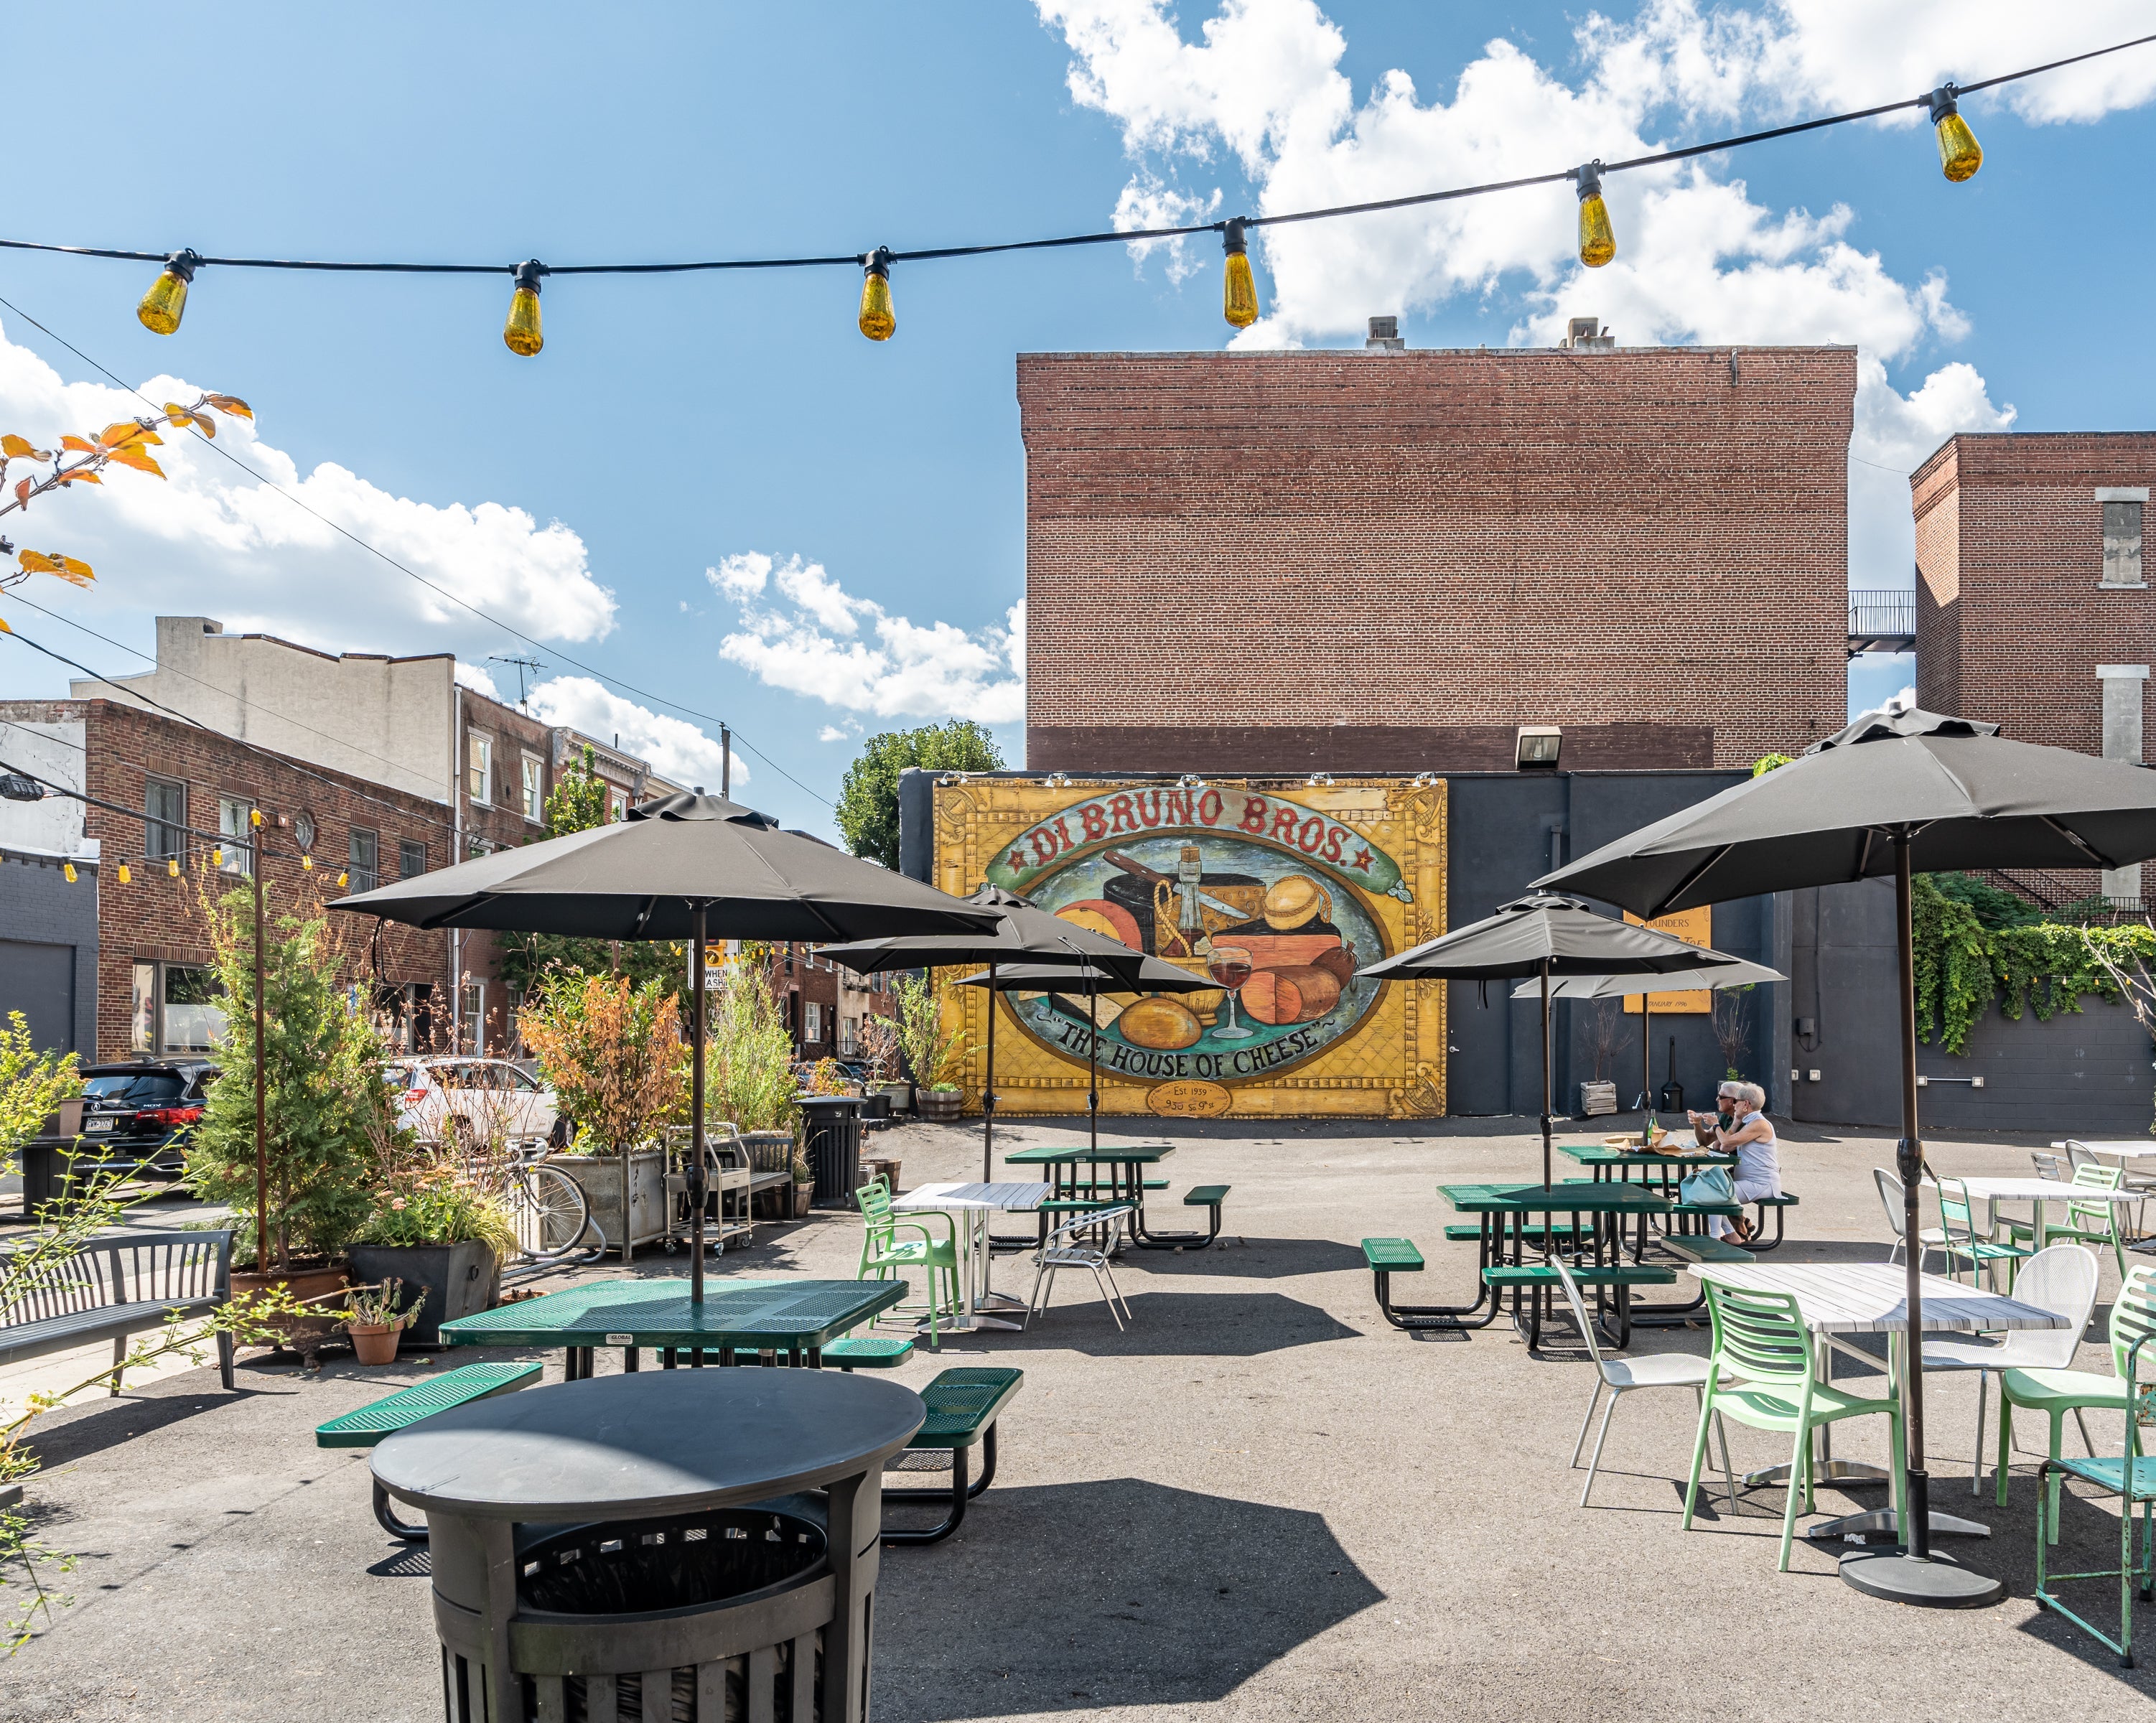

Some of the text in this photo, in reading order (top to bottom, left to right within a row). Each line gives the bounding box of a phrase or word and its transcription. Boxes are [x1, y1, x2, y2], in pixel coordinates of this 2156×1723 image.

[1027, 789, 1352, 867] DI BRUNO BROS.
[1109, 1044, 1188, 1077] HOUSE
[1195, 1053, 1224, 1078] OF
[1191, 1088, 1208, 1096] 1939
